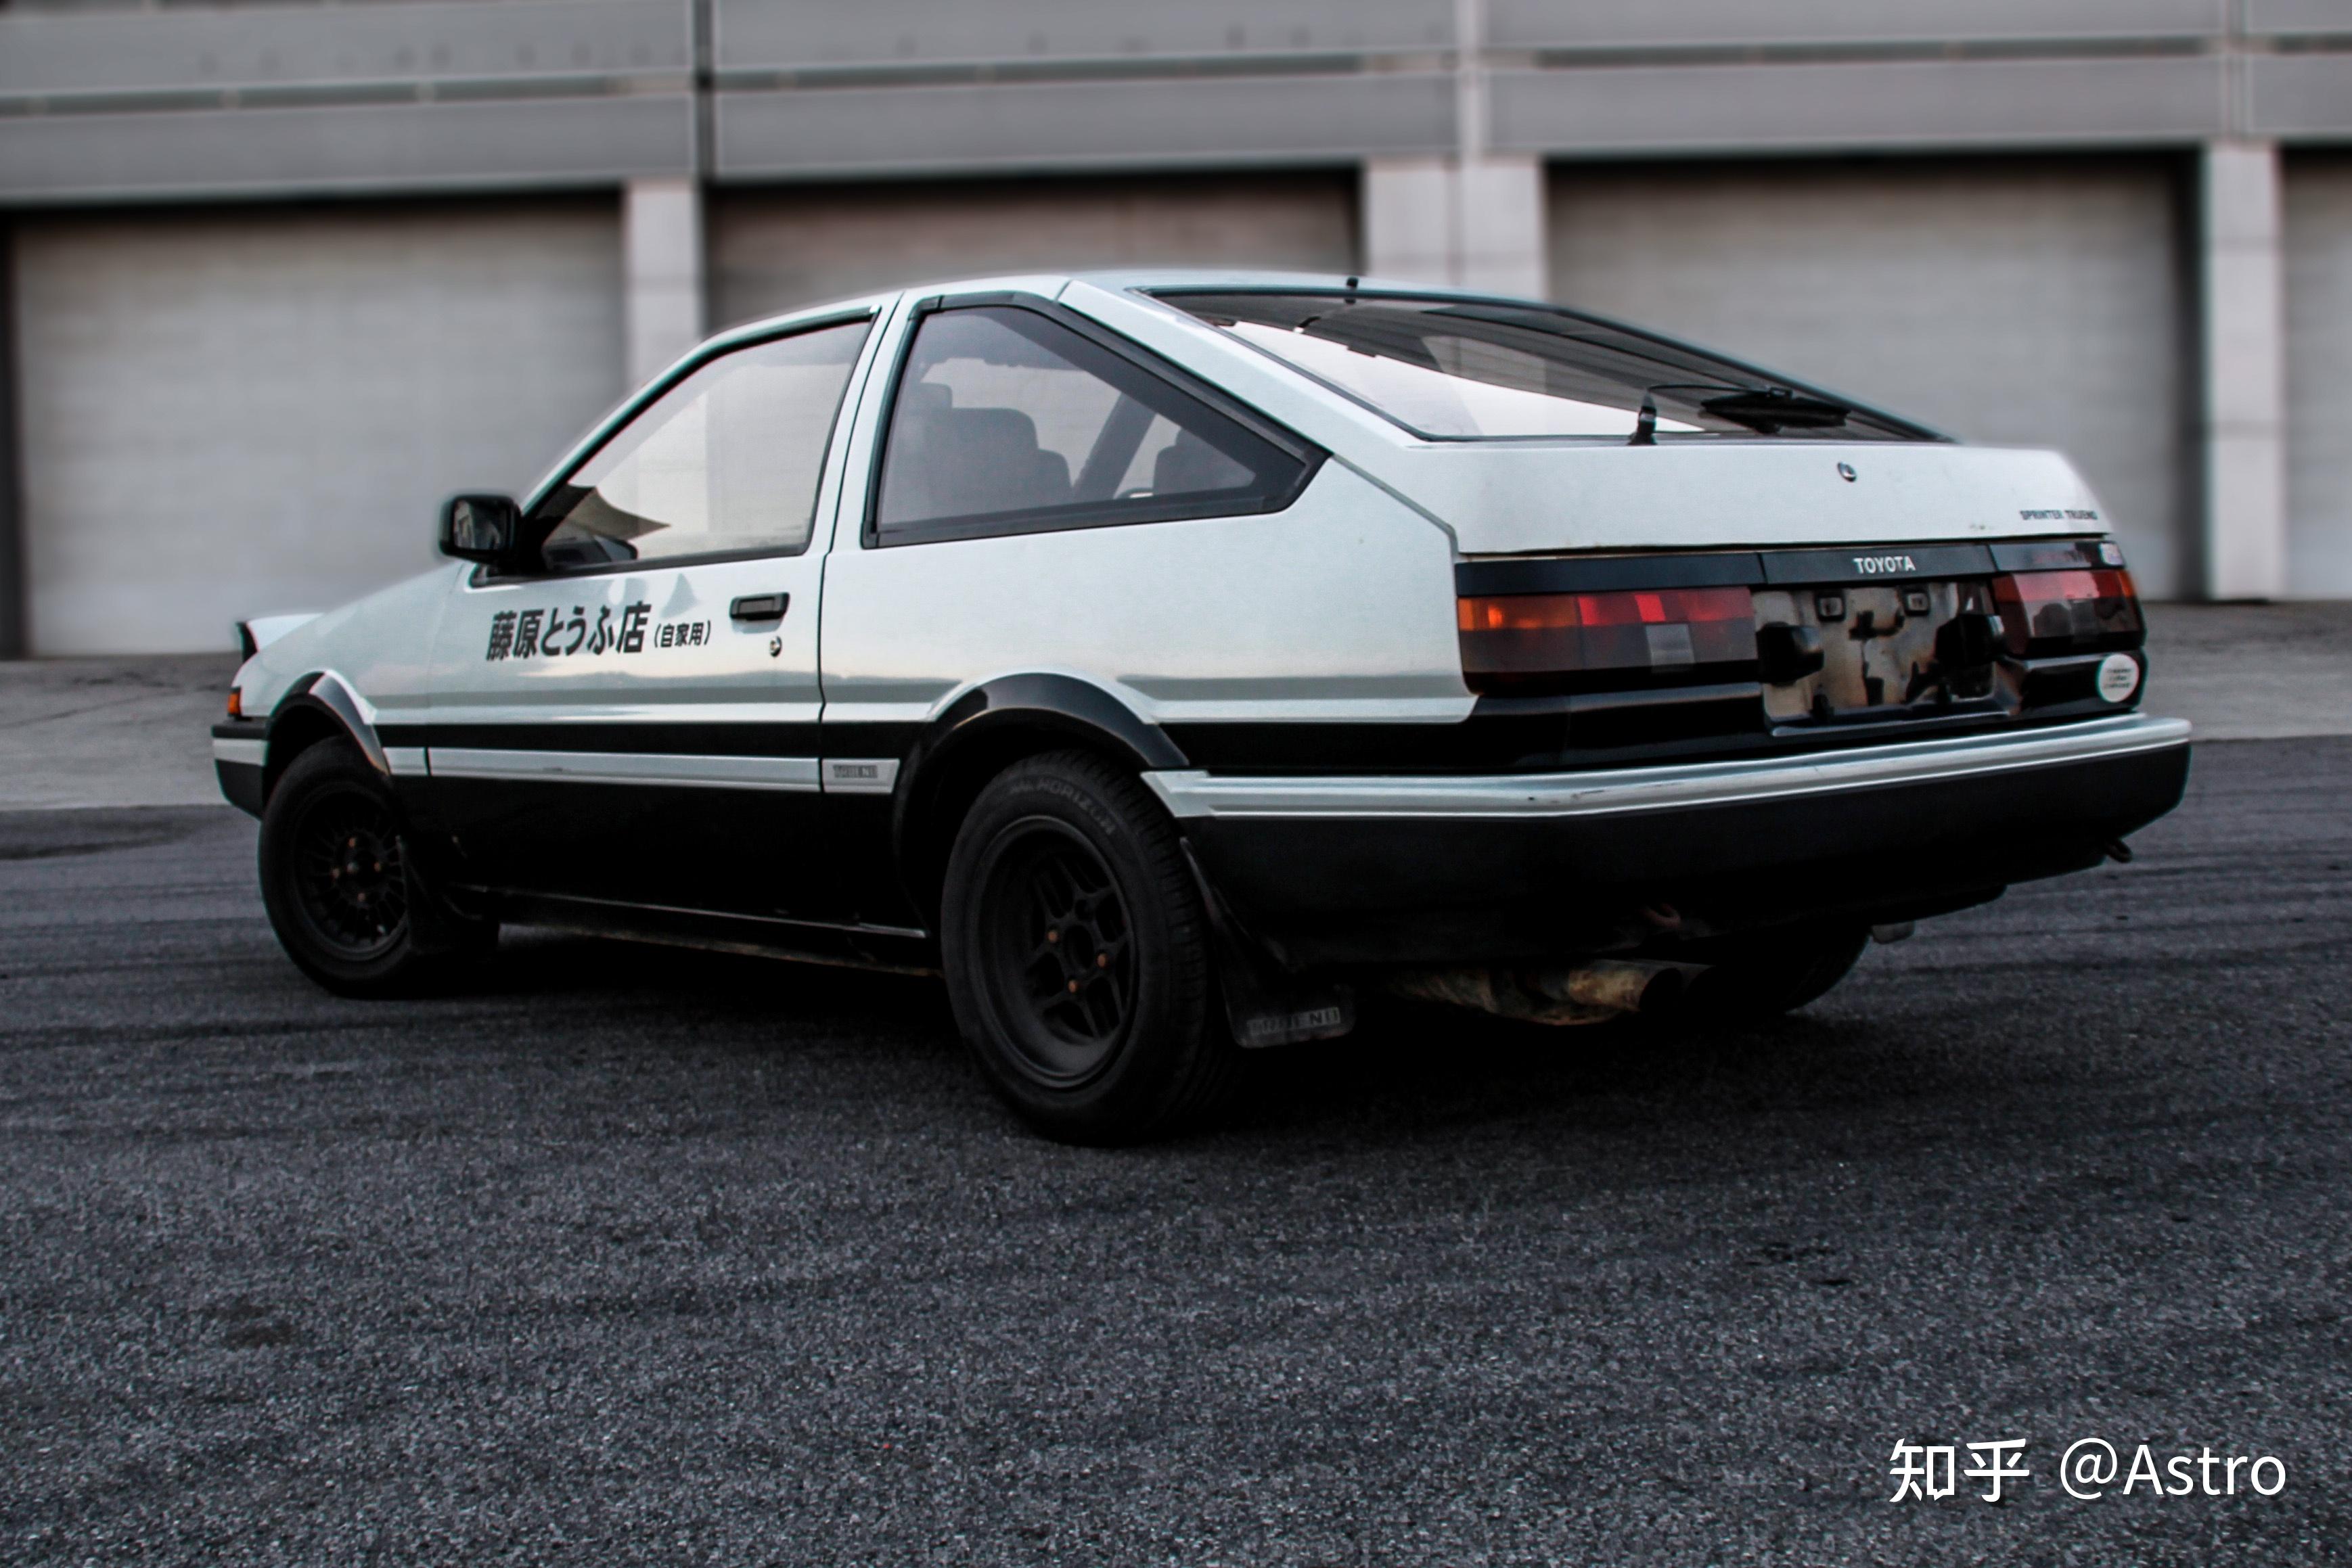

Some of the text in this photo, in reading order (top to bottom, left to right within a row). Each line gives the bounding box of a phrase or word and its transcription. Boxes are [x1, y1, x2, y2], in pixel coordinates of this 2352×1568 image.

[1853, 555, 1916, 574] TOYOTA
[487, 601, 652, 661] 藤原とうふ店
